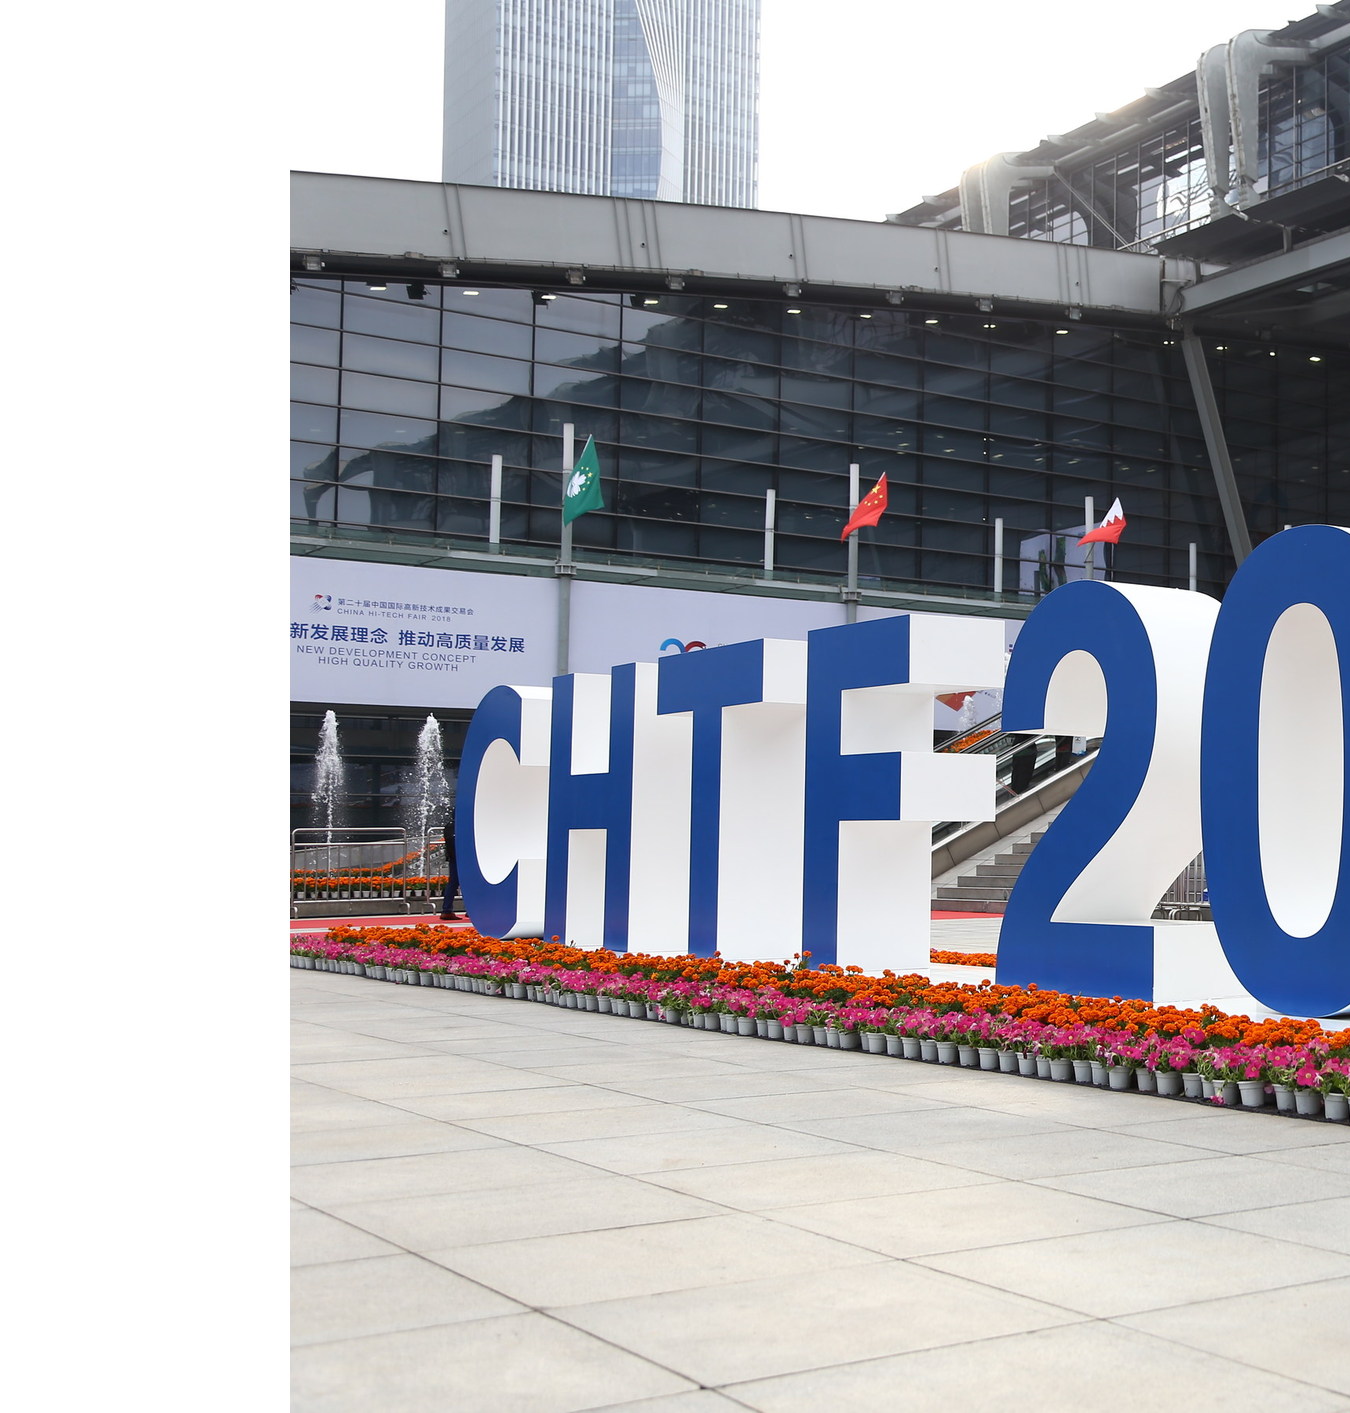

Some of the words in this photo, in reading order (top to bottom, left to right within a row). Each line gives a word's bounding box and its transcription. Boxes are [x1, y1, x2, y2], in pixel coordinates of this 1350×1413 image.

[337, 598, 474, 616] 第二十届中国国际高新技术成果交易会
[337, 608, 365, 616] CHINA
[368, 610, 404, 619] HI-TECH
[407, 613, 427, 621] FAIR
[431, 615, 451, 623] 2018
[290, 622, 388, 645] 新发展理念
[398, 629, 525, 653] 推动高质量发展
[296, 644, 326, 655] NEW
[329, 646, 418, 661] DEVELOPMENT
[422, 652, 477, 664] CONCEPT
[318, 655, 349, 666] HIGH
[352, 657, 404, 669] QUALITY
[407, 661, 459, 672] GROWTH
[455, 617, 911, 966] CHTF
